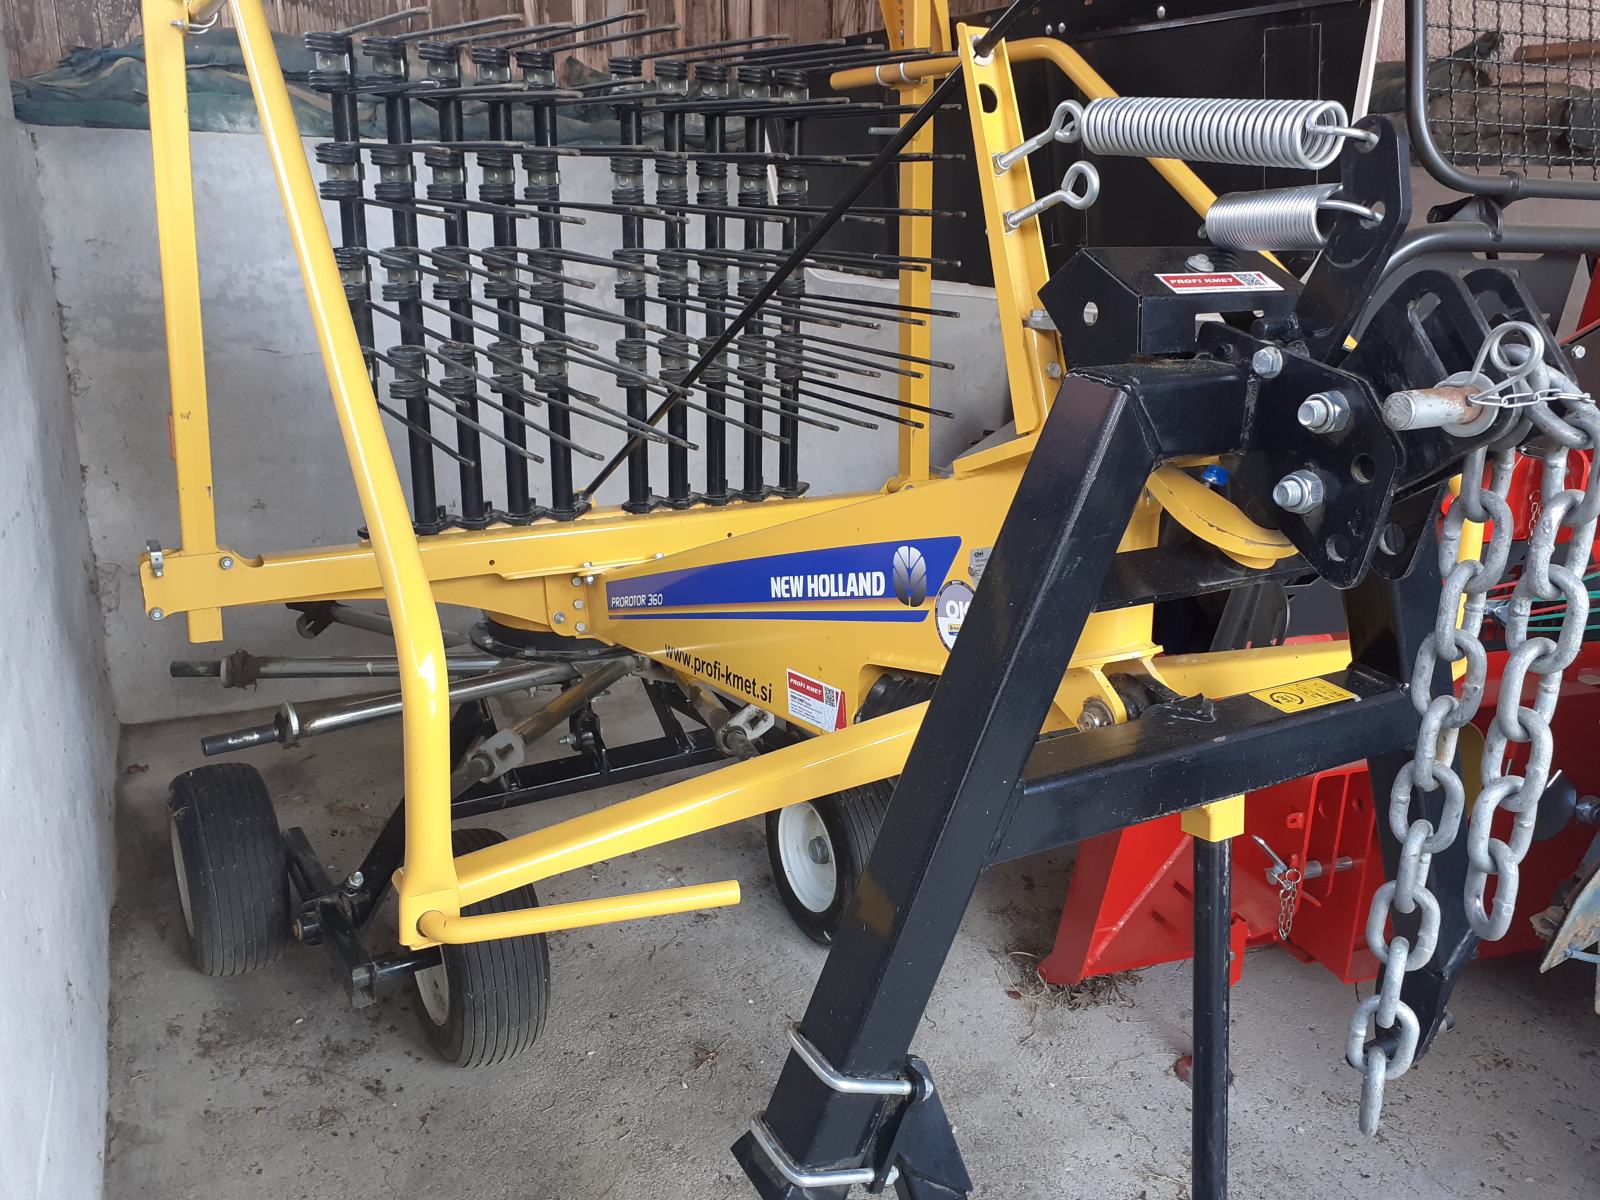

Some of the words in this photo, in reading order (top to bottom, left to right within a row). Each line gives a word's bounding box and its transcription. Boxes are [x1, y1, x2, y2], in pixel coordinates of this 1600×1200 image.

[1203, 277, 1234, 285] KMET
[770, 575, 804, 598] NEW
[807, 571, 886, 597] HOLLAND
[611, 594, 647, 608] PROROTOR
[647, 593, 663, 606] 360
[945, 600, 971, 619] OK
[664, 643, 773, 703] www.profi-kmet.si
[789, 678, 806, 689] PROFI
[806, 685, 822, 696] KMET
